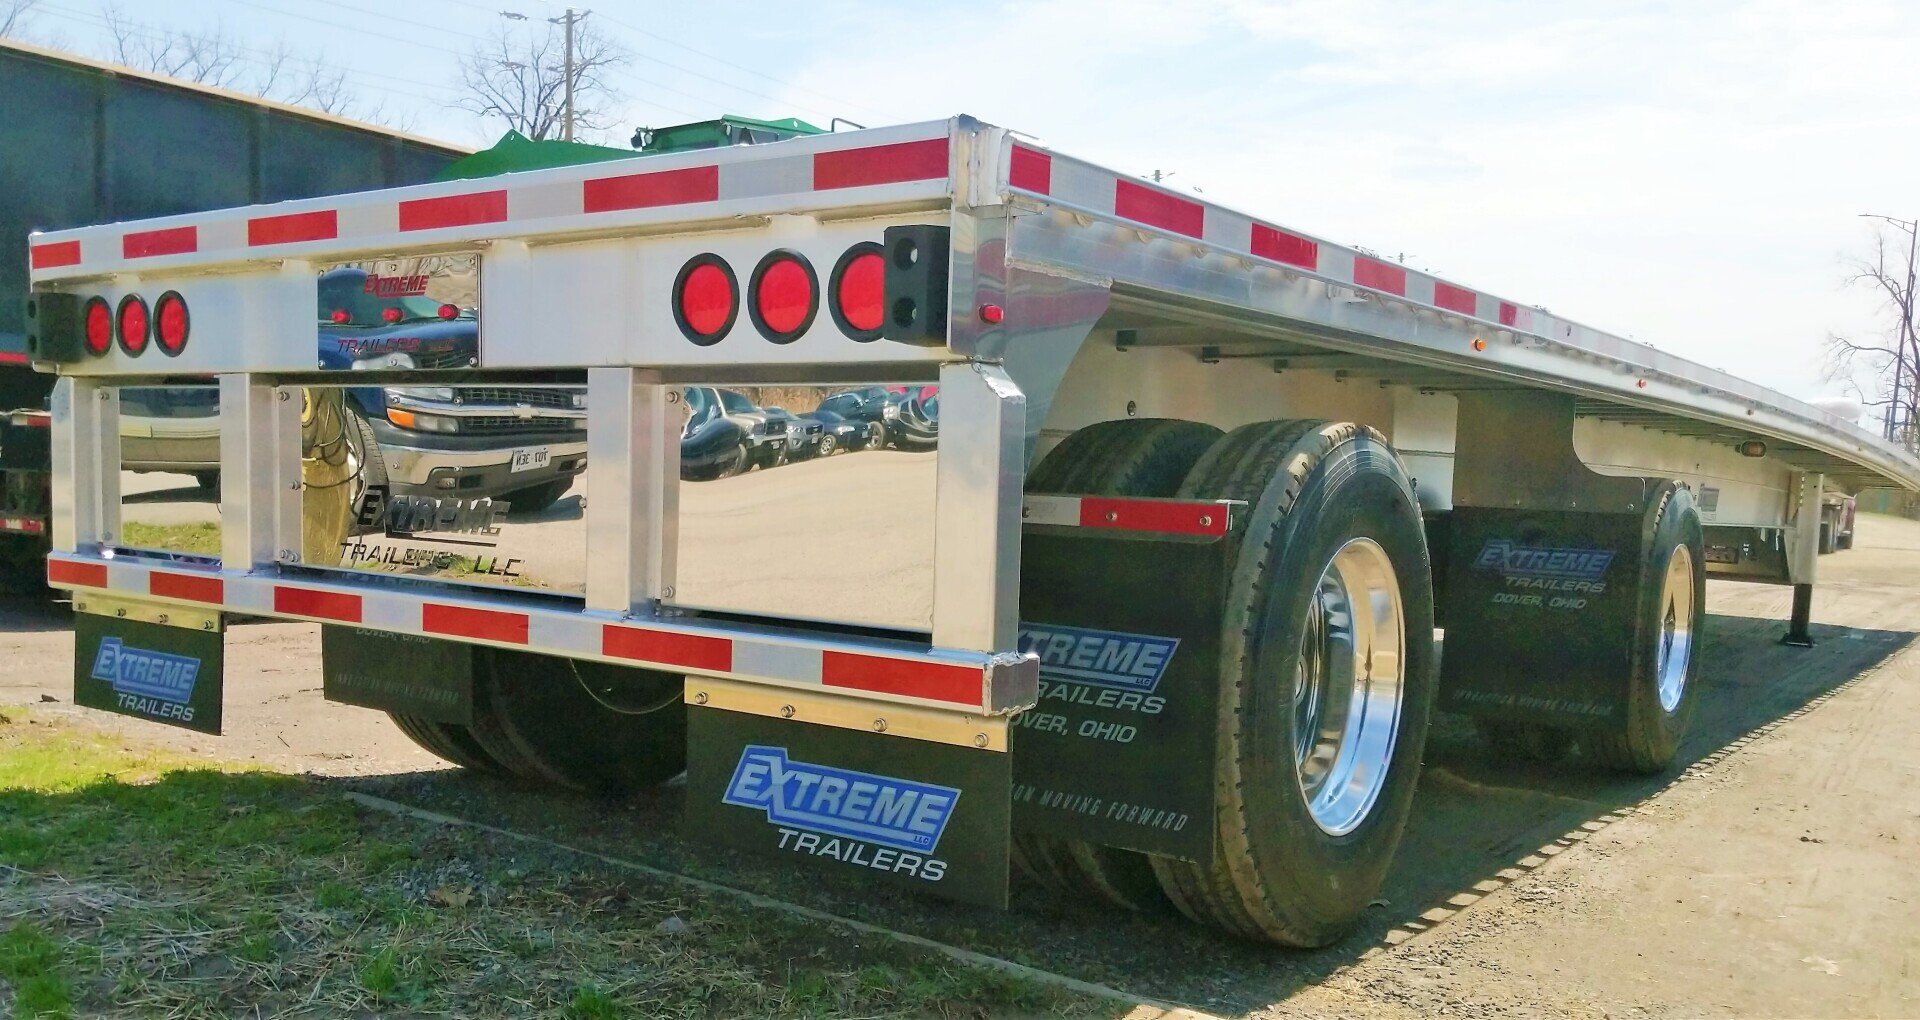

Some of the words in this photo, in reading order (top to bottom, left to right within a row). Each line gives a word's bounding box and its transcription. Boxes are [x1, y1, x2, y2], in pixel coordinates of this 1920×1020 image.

[364, 274, 429, 297] EXTREME
[338, 337, 421, 352] TRAILERS
[357, 485, 511, 538] EXTREME
[341, 542, 451, 569] TRAILERS
[473, 555, 521, 576] LLC
[1480, 544, 1609, 572] EXTREME
[1505, 576, 1607, 593] TRAILERS
[1549, 597, 1587, 609] OHIO
[97, 644, 196, 689] EXTREME
[1018, 629, 1170, 677] TREME
[118, 693, 194, 722] TRAILERS
[1038, 681, 1167, 714] RAILERS
[1009, 710, 1068, 737] OVER,
[1079, 719, 1137, 743] OHIO
[733, 755, 951, 835] EXTREME
[1039, 789, 1102, 816] MOVING
[1106, 801, 1189, 832] FORWARD
[778, 828, 948, 882] TRAILERS
